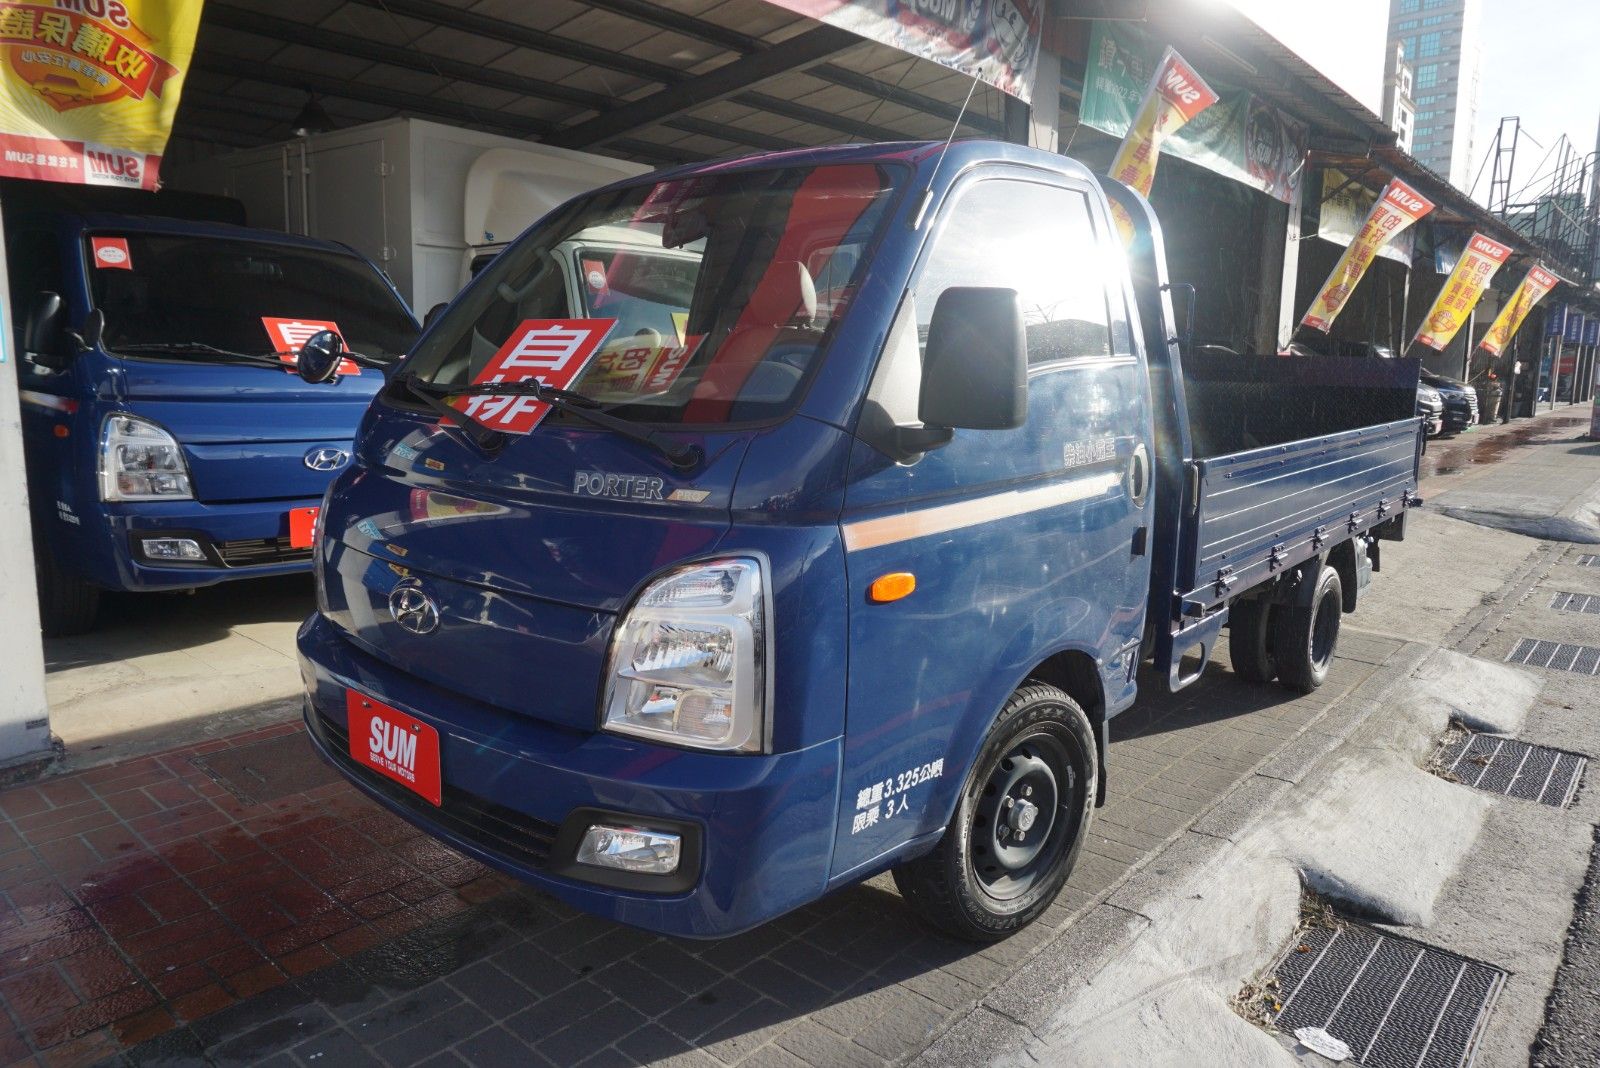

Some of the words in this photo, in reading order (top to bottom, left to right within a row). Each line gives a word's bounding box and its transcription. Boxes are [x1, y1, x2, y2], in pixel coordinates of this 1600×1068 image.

[464, 325, 592, 424] 自排
[573, 471, 664, 499] PORTER
[369, 716, 417, 771] SUM
